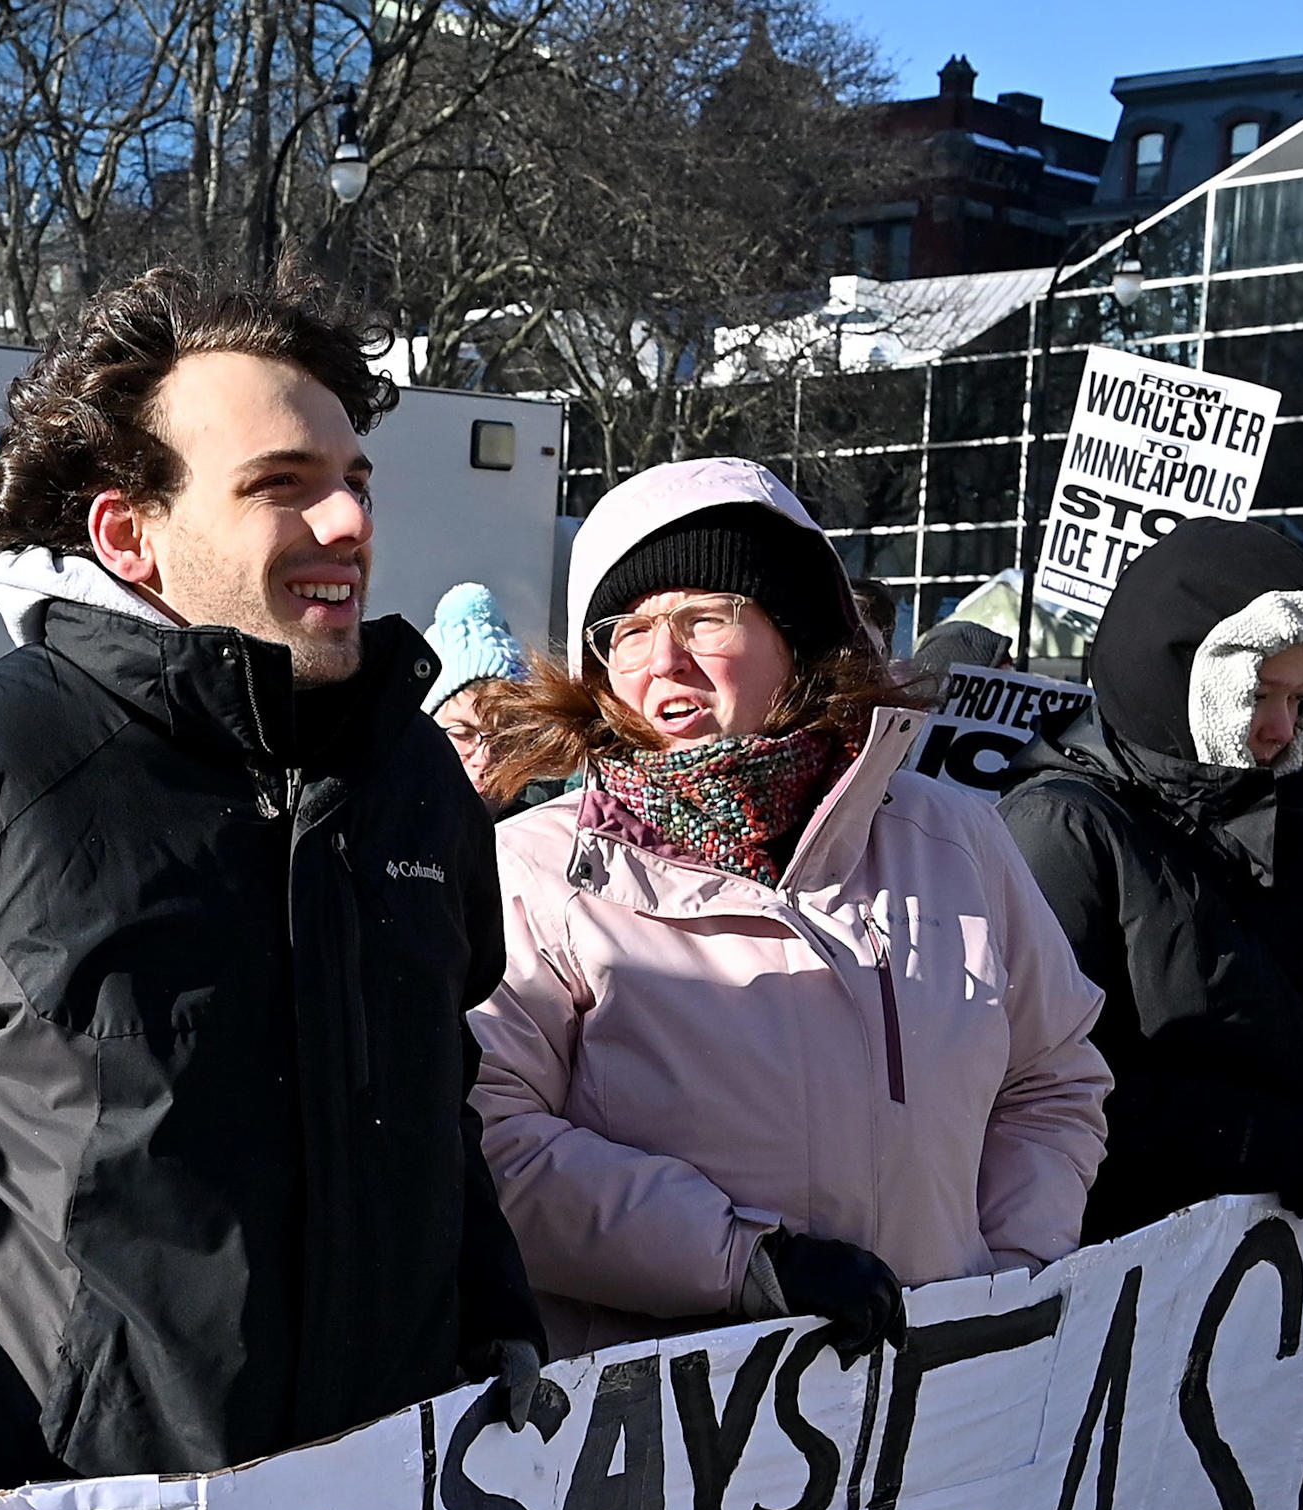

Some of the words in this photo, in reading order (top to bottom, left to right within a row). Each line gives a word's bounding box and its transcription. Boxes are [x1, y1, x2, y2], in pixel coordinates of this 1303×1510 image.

[1087, 370, 1266, 457] WORCESTER
[1141, 373, 1222, 404] FROM
[1069, 432, 1247, 515] MINNEAPOLIS
[1146, 438, 1183, 459] TO
[1059, 484, 1188, 541] STO
[1048, 519, 1098, 573] ICE
[1101, 535, 1150, 582] TE
[915, 724, 1028, 791] IC
[399, 861, 445, 883] Columbia
